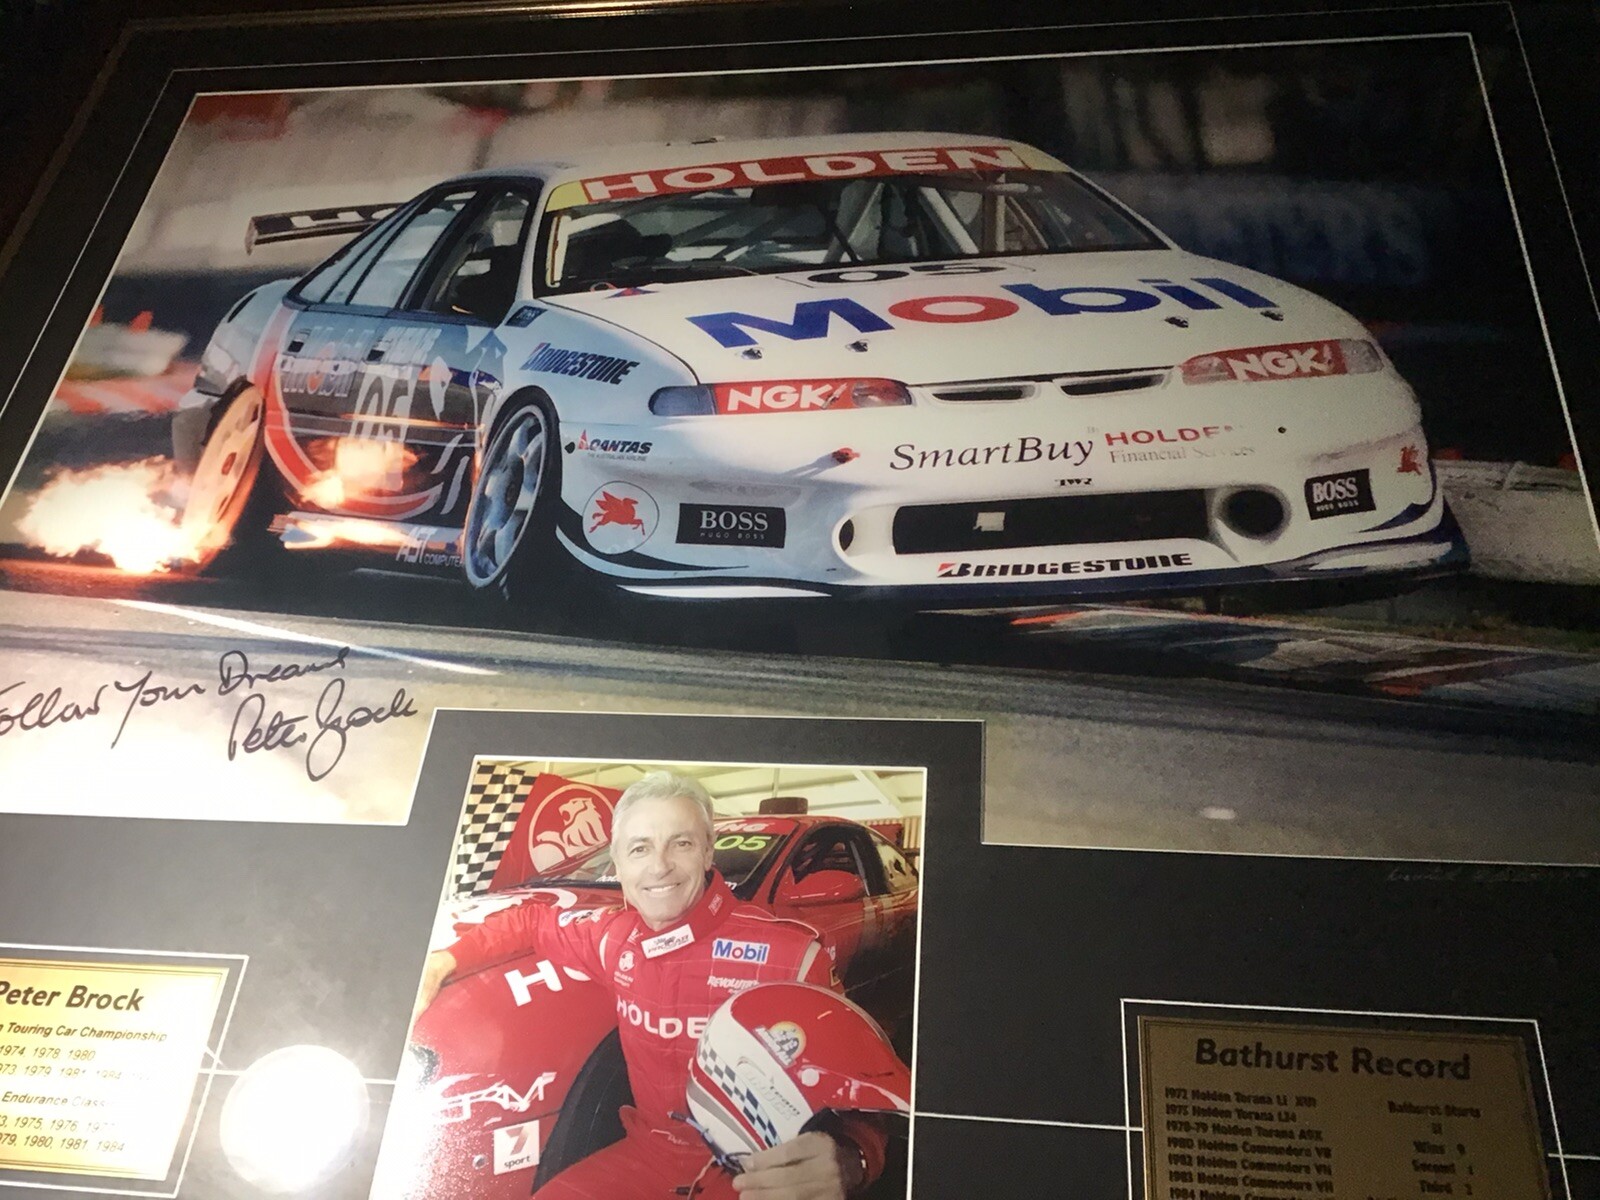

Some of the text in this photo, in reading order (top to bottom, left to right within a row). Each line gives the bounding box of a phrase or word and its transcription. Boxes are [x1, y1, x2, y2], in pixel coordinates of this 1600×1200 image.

[586, 146, 1028, 200] HOLDEN
[686, 278, 1280, 348] Mobil
[519, 342, 640, 385] BRIDGESTONE
[1229, 347, 1332, 381] NGK
[727, 384, 842, 411] NGK
[589, 438, 653, 454] QANTAS
[889, 437, 1093, 470] SmartBuy
[1110, 446, 1190, 463] Financial
[1312, 477, 1359, 503] BOSS
[700, 510, 768, 531] BOSS
[937, 553, 1193, 578] BRIDGESTONE
[713, 835, 772, 851] 05
[714, 940, 768, 962] Mobil
[65, 984, 144, 1012] Brock
[7, 1022, 53, 1038] Touring
[56, 1025, 78, 1036] Car
[80, 1026, 167, 1043] Championship
[1195, 1037, 1471, 1081] Bathurst Record
[3, 1091, 69, 1106] Endurance
[504, 1155, 531, 1169] sport
